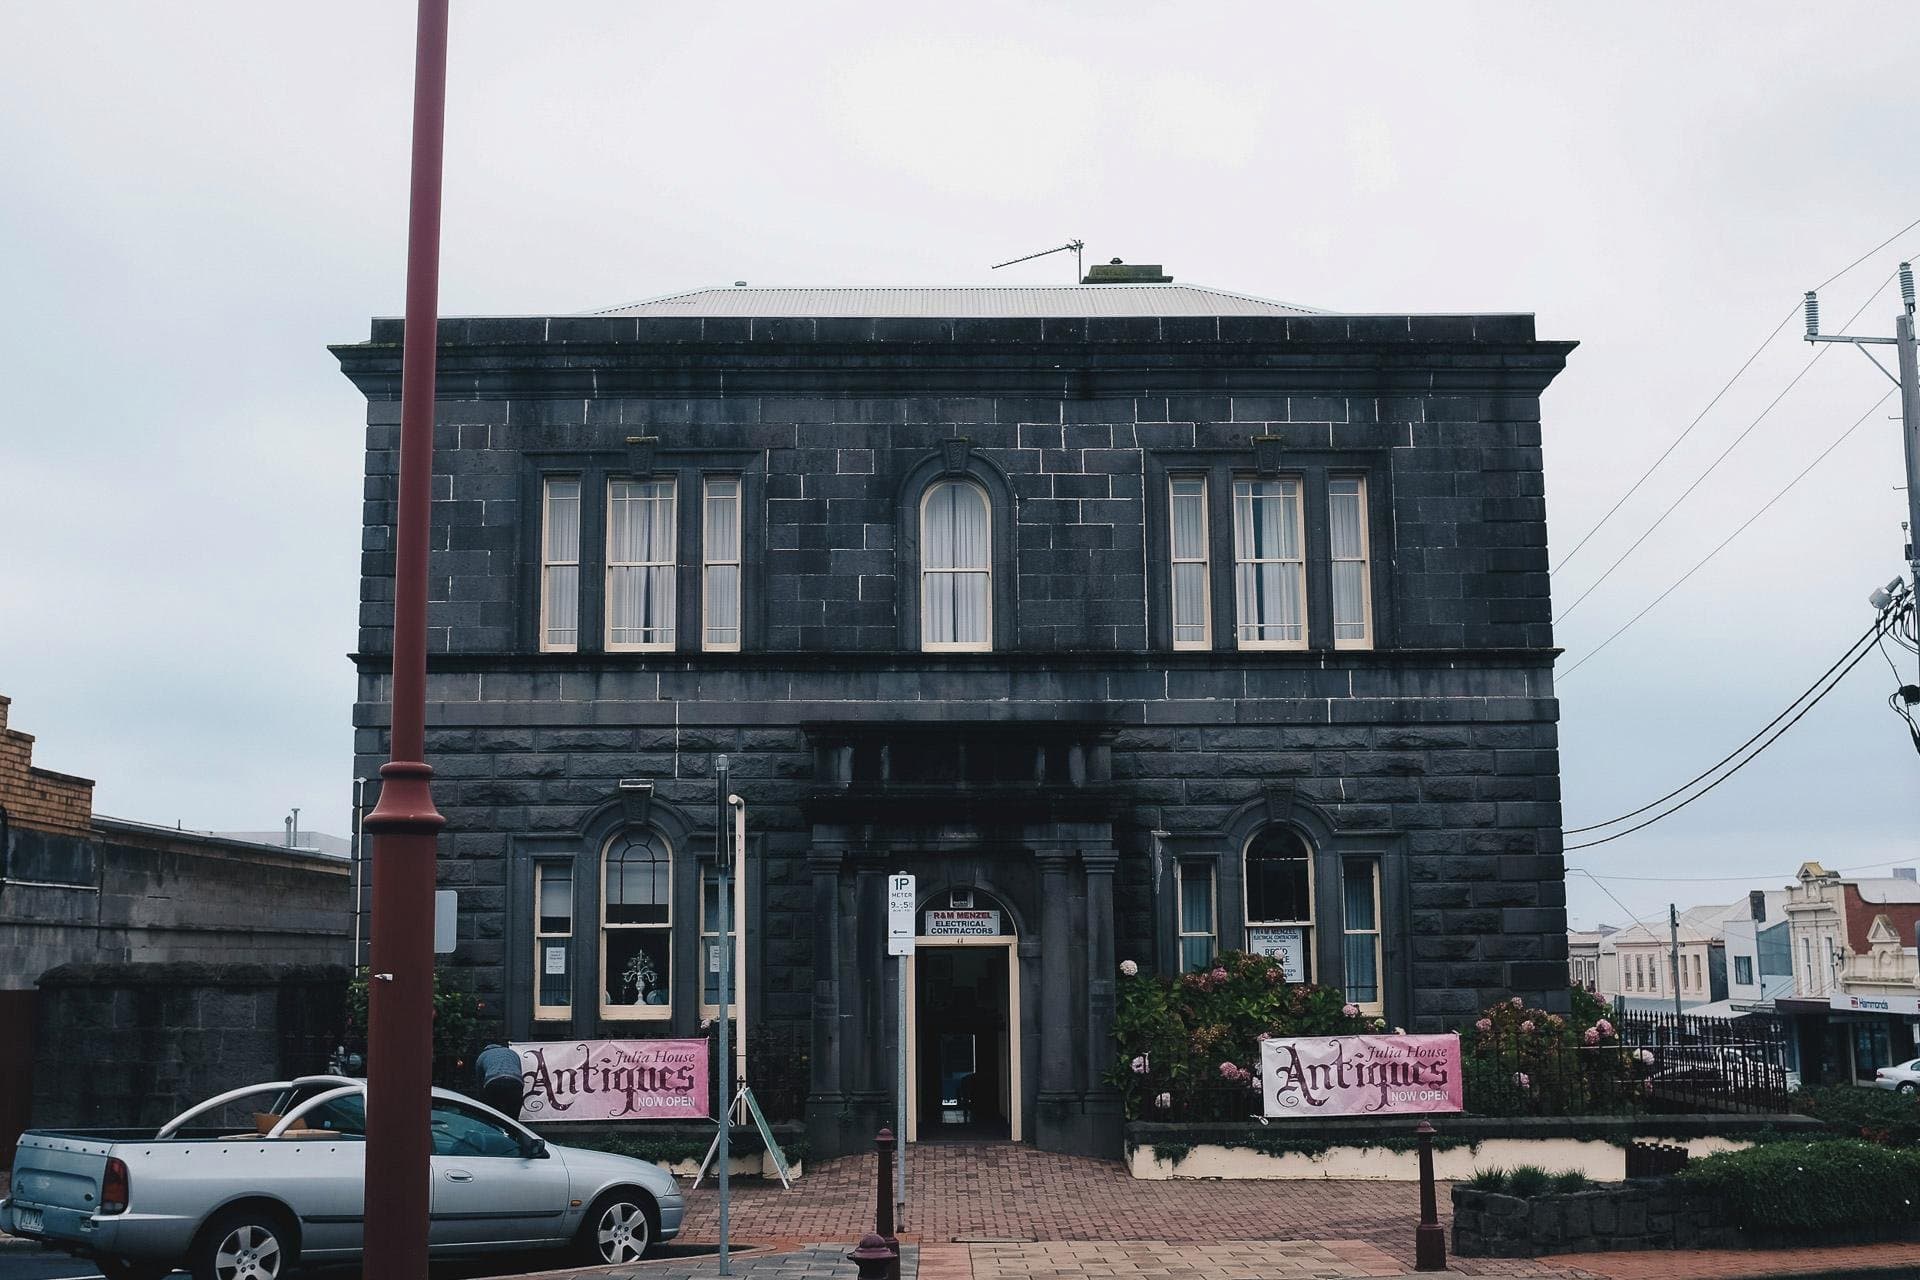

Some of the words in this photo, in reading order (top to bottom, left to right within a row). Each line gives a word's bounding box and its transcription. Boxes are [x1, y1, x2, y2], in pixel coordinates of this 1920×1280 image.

[894, 877, 910, 890] 1P
[930, 927, 994, 935] CONTRACTORS
[1859, 997, 1889, 1010] Hammonds
[614, 1050, 650, 1067] Julia
[653, 1049, 696, 1063] House
[1366, 1046, 1402, 1062] Julia
[1406, 1045, 1447, 1058] House
[522, 1043, 696, 1117] Antiques
[1275, 1039, 1448, 1112] Antiques
[637, 1097, 663, 1107] NOW
[666, 1096, 695, 1107] OPEN
[1391, 1091, 1417, 1102] NOW
[1419, 1090, 1449, 1101] OPEN
